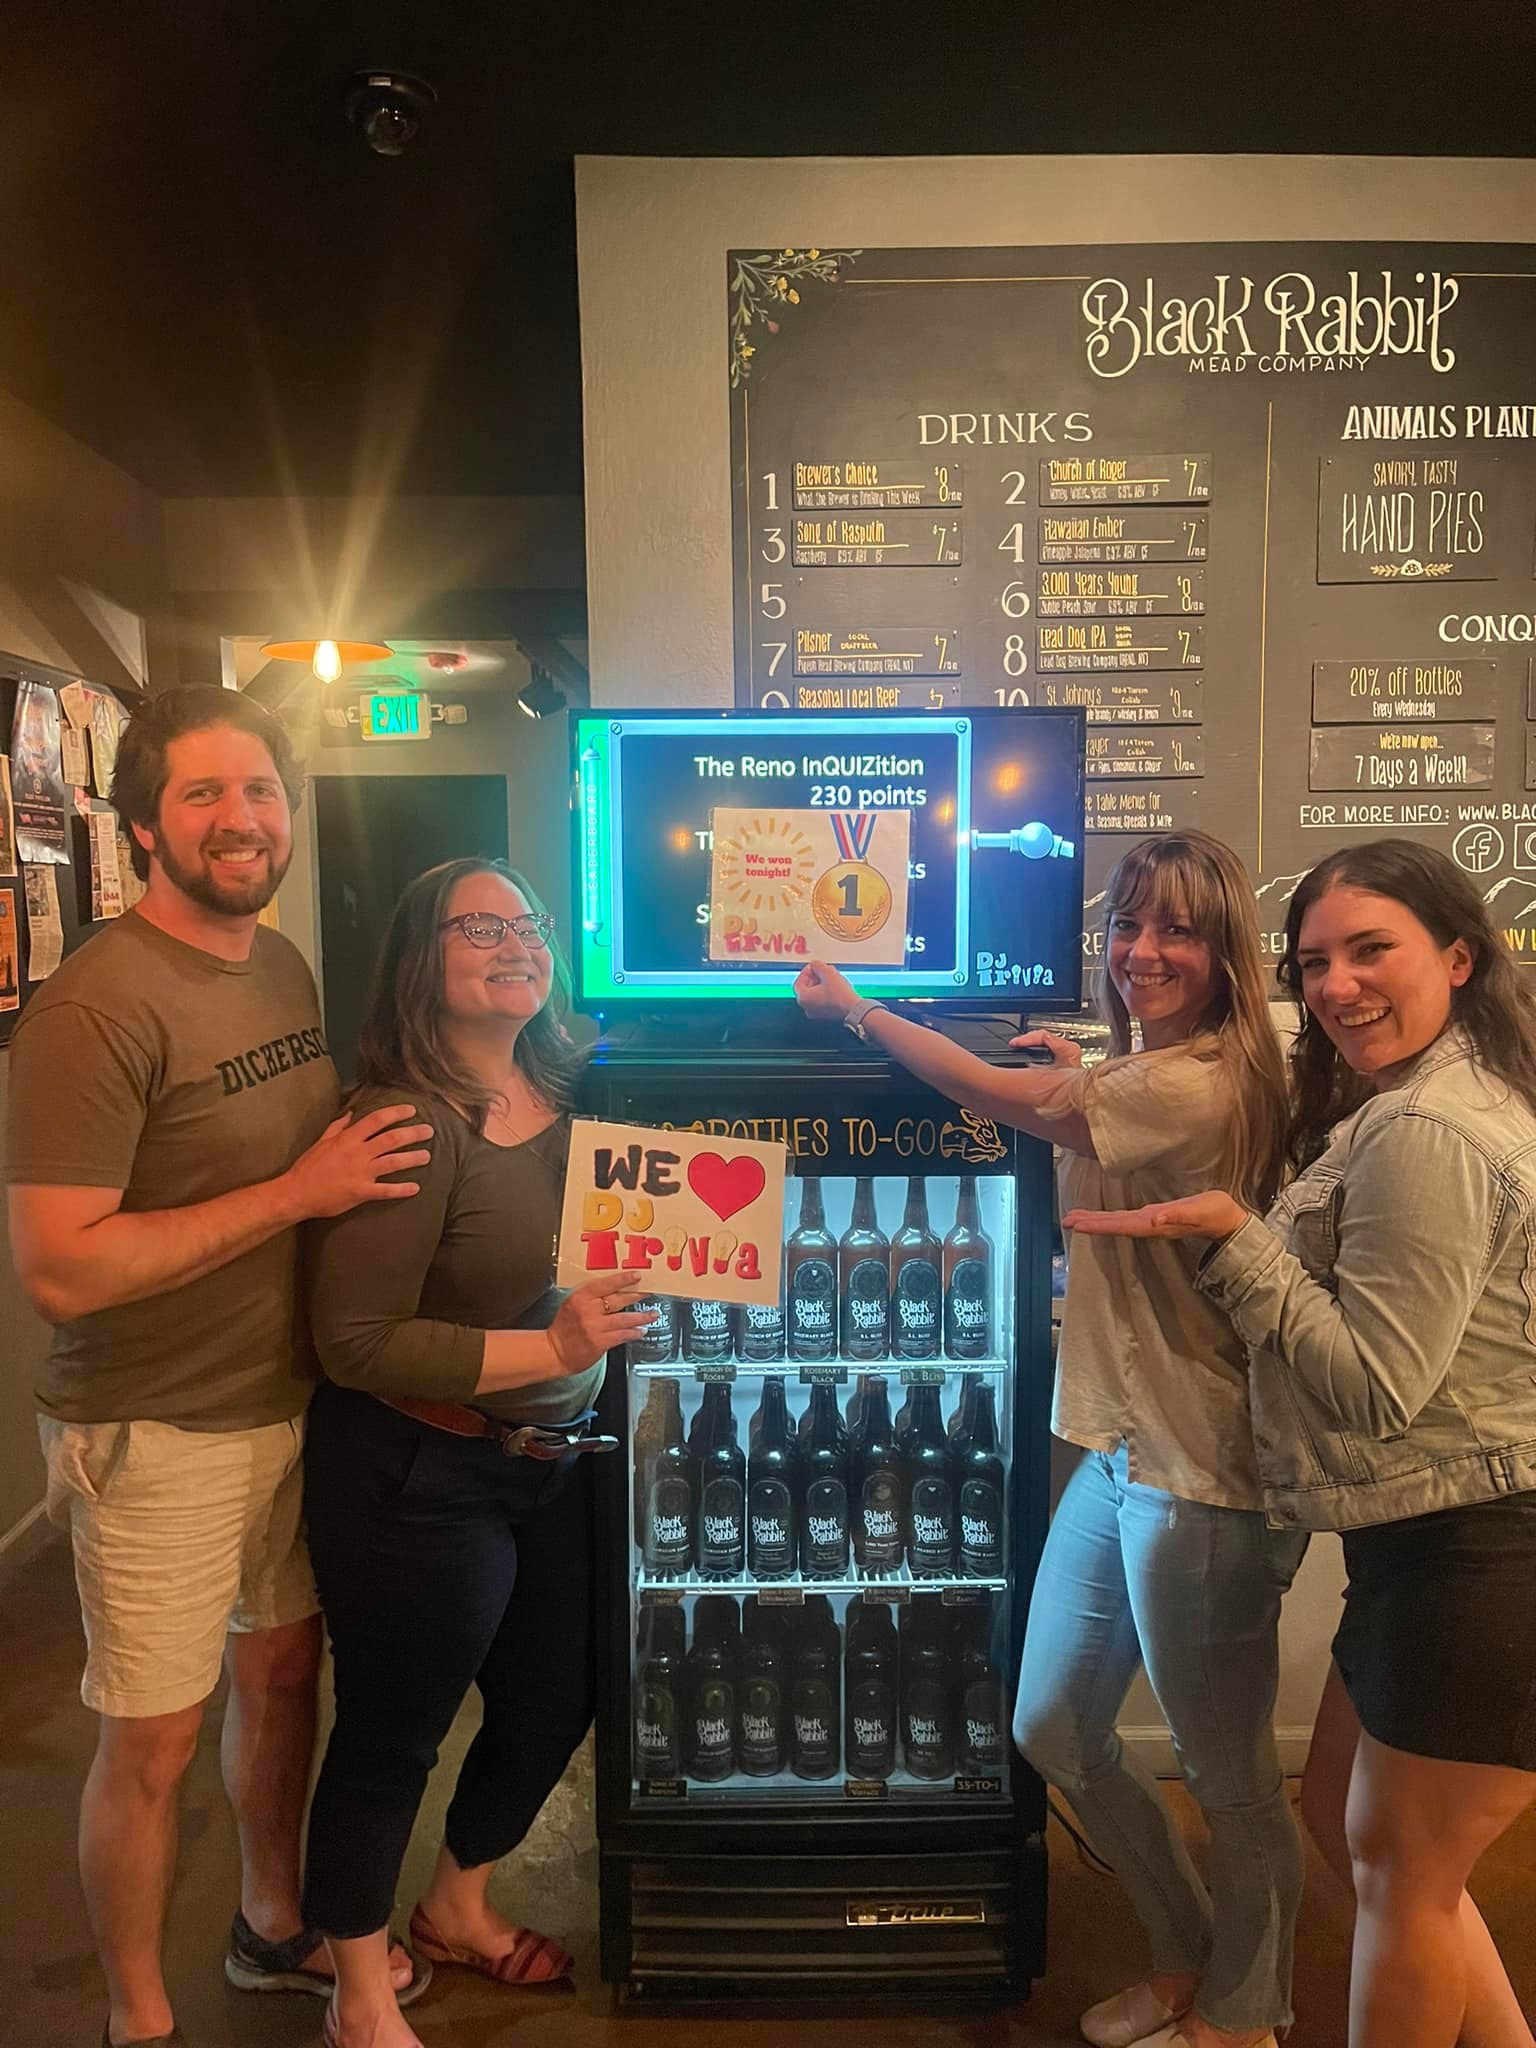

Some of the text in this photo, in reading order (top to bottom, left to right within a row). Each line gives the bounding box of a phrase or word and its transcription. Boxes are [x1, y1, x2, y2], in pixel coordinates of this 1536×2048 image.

[1082, 271, 1459, 378] Black Rabbit
[1189, 355, 1370, 373] MEAD COMPANY
[918, 411, 1094, 446] DRINKS
[1341, 404, 1457, 440] ANIMALS
[796, 462, 878, 486] Brewer's Choice
[1050, 458, 1127, 482] Church of Roger
[1423, 460, 1457, 486] TASTY
[762, 472, 779, 510] 1
[1000, 471, 1026, 505] 2
[1044, 515, 1126, 541] Hawaiian Ember
[1342, 490, 1483, 554] HAND PIES
[797, 520, 885, 545] Song of Rasputin
[998, 522, 1025, 563] 4
[762, 528, 786, 564] 3
[1074, 571, 1103, 595] Years
[1107, 571, 1139, 596] Young
[762, 583, 787, 620] 5
[1001, 581, 1030, 618] 6
[1040, 624, 1107, 650] Lead Dog IPA
[1438, 614, 1536, 643] CONQ
[797, 630, 833, 654] Pilsner
[761, 642, 788, 677] 7
[1003, 634, 1028, 677] 8
[1350, 665, 1463, 697] 20% off Bottles
[799, 686, 844, 708] Seasonal
[847, 686, 873, 708] Local
[876, 686, 900, 708] Beer
[1062, 683, 1102, 707] Johnny's
[371, 695, 420, 734] EXIT
[1373, 699, 1436, 719] Every Wednesday
[1086, 737, 1110, 756] rayer
[695, 755, 924, 778] The Reno InQUIZition
[1354, 753, 1467, 788] 7 Days a Week!
[810, 784, 927, 810] 230 points
[1096, 793, 1117, 812] Table
[1119, 793, 1146, 811] Menus
[1149, 792, 1160, 810] for
[1300, 804, 1336, 825] FOR
[1344, 805, 1394, 823] MORE
[1401, 804, 1450, 822] INFO:
[745, 854, 793, 865] We won
[745, 867, 791, 879] tonight!
[837, 874, 863, 916] 1
[723, 915, 758, 934] DJ
[976, 951, 1007, 969] DJ
[842, 1117, 937, 1157] TO-GO
[594, 1143, 682, 1196] WE
[582, 1191, 654, 1233] DJ
[692, 1301, 721, 1318] Black
[795, 1299, 824, 1315] Black
[851, 1299, 881, 1316] Black
[900, 1299, 929, 1315] Black
[953, 1298, 983, 1315] Black
[694, 1314, 727, 1331] Rabbit
[748, 1312, 782, 1329] Rabbit
[796, 1311, 830, 1329] Rabbit
[853, 1312, 886, 1329] Rabbit
[901, 1312, 935, 1329] Rabbit
[811, 1375, 834, 1383] BLACK
[653, 1515, 682, 1531] Black
[704, 1515, 733, 1531] Black
[752, 1515, 780, 1532] Black
[808, 1515, 837, 1532] Black
[863, 1509, 892, 1526] Black
[913, 1514, 942, 1530] Black
[961, 1514, 989, 1532] Black
[655, 1526, 688, 1544] Rabbit
[707, 1526, 739, 1544] Rabbit
[754, 1529, 786, 1544] Rabbit
[811, 1527, 843, 1545] Rabbit
[866, 1521, 899, 1538] Rabbit
[916, 1527, 949, 1544] Rabbit
[963, 1529, 995, 1545] Rabbit
